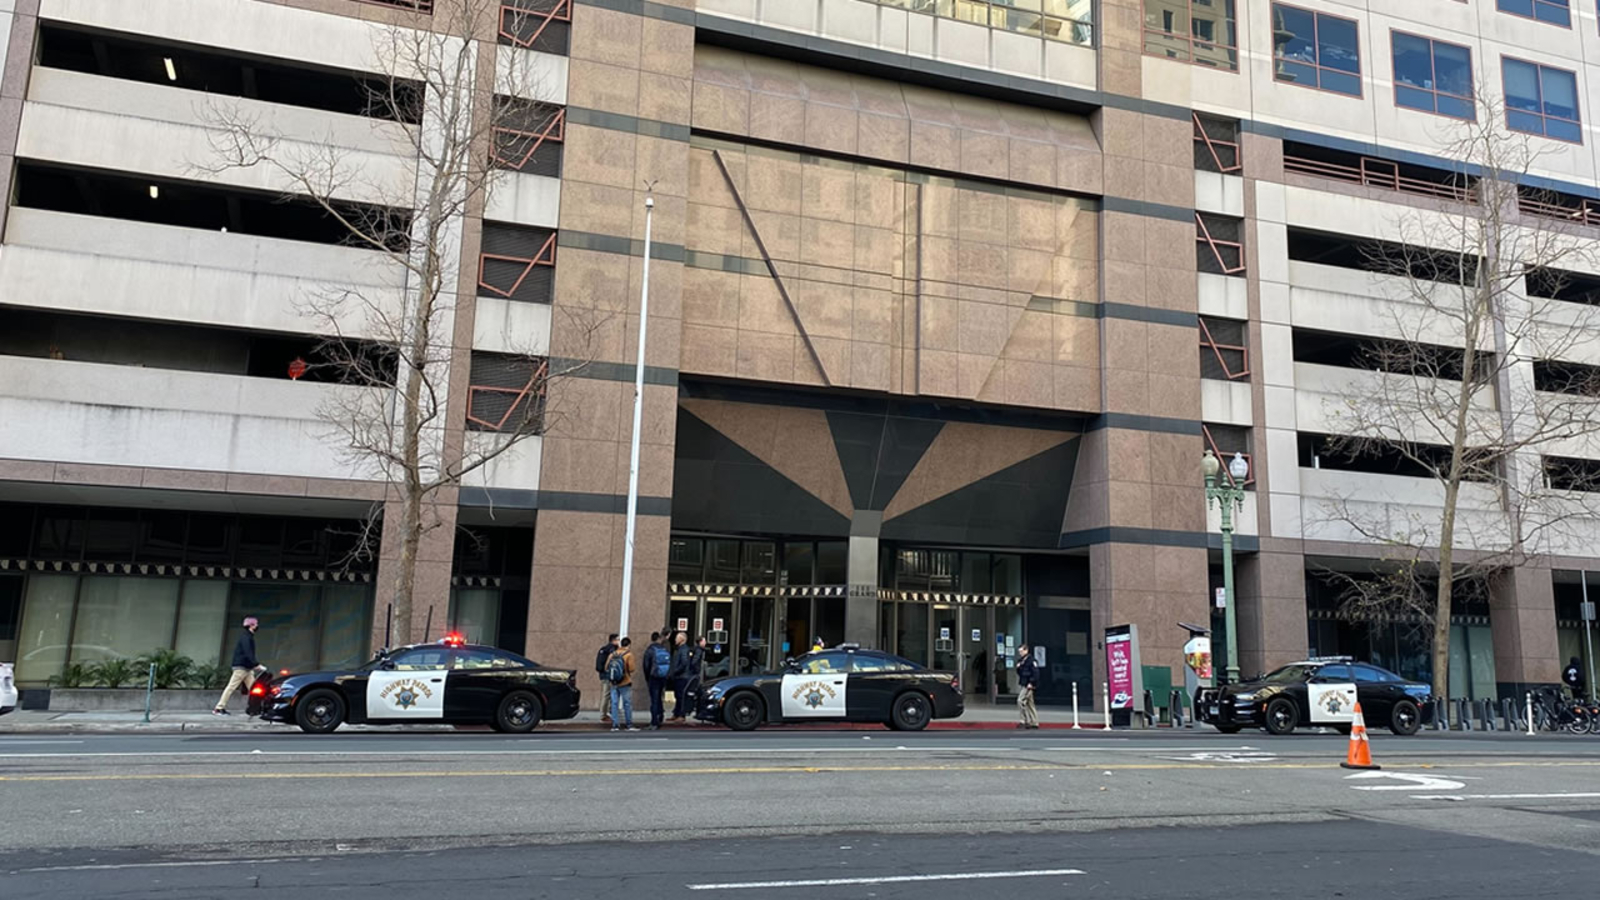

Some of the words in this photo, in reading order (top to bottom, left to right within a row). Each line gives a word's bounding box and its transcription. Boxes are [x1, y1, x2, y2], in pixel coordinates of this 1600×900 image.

[380, 679, 410, 699] HIGHWAY
[412, 679, 433, 699] PATROL
[792, 681, 817, 700] HIGHWAY
[819, 681, 837, 699] PATROL
